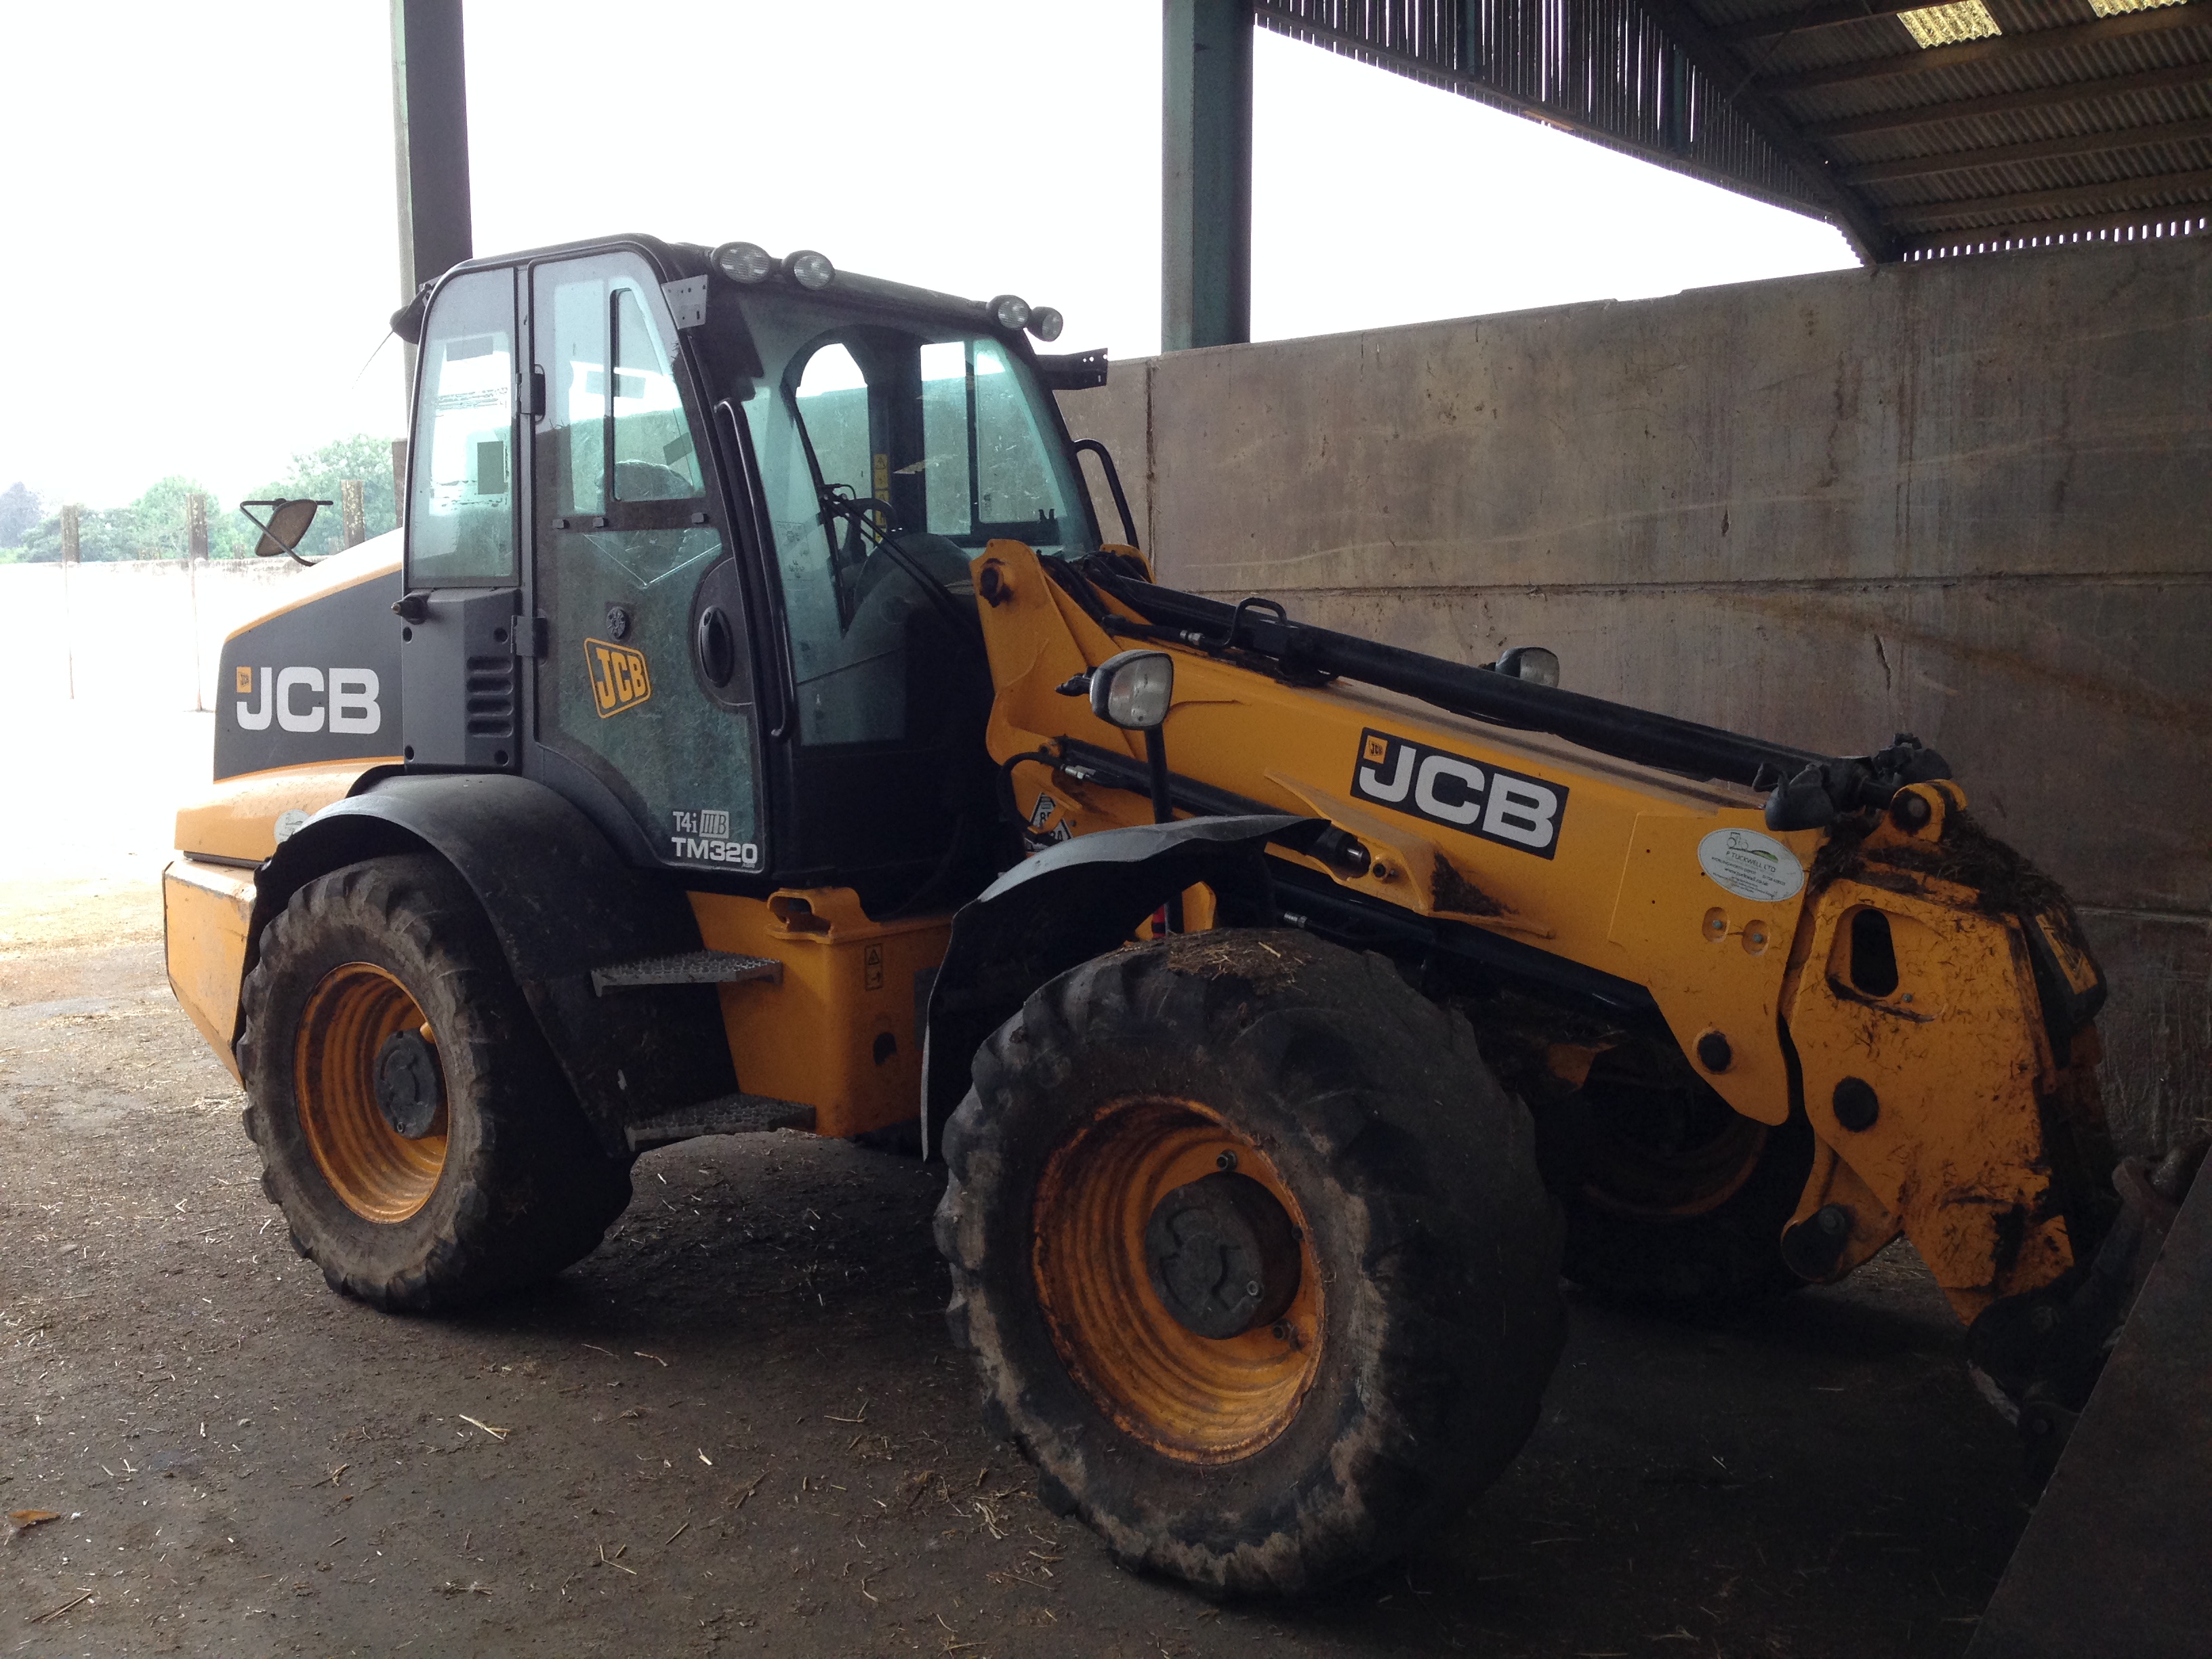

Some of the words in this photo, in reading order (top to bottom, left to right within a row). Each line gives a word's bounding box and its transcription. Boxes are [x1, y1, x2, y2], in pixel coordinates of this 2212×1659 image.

[596, 647, 645, 709] JCB
[237, 667, 381, 734] JCB
[1359, 745, 1557, 848] JCB
[673, 811, 698, 833] T4i
[671, 837, 758, 864] TM320
[1732, 853, 1762, 867] TUCKWELL
[1764, 864, 1776, 873] LTD
